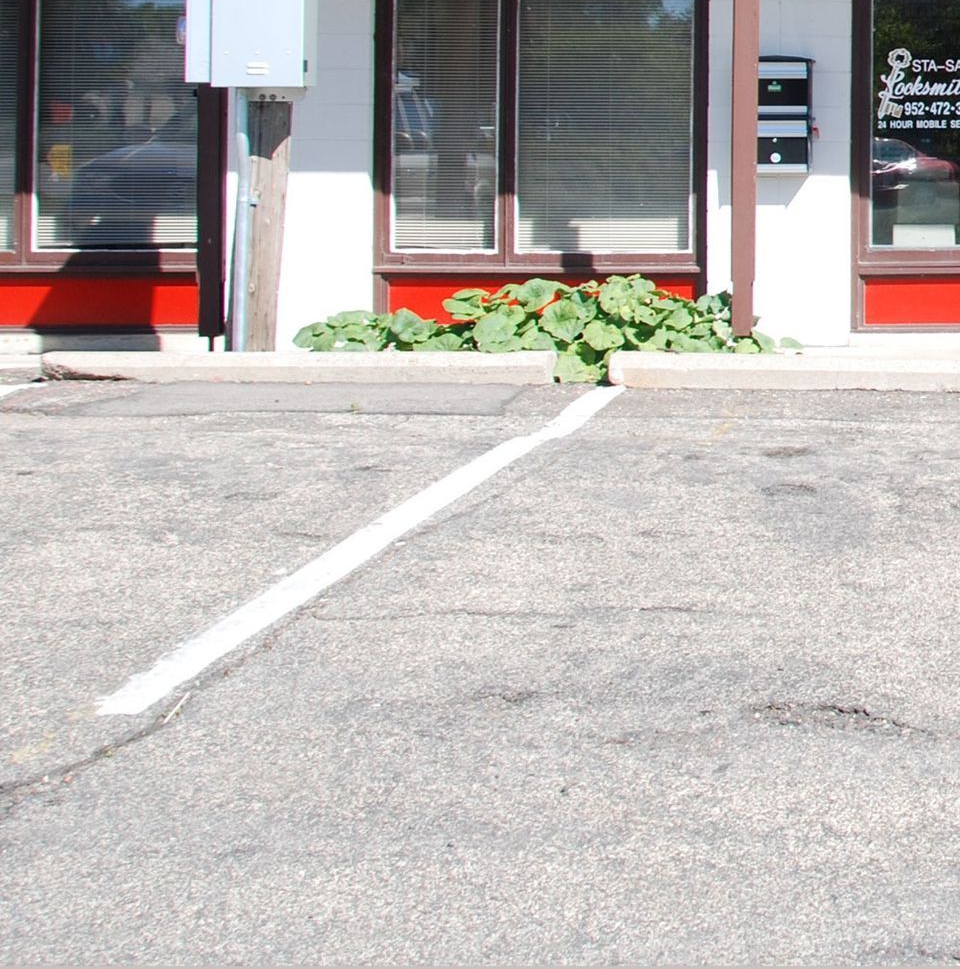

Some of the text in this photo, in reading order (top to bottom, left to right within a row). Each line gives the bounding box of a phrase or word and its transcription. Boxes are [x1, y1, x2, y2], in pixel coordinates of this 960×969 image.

[877, 120, 887, 129] 24
[890, 119, 913, 129] HOUR
[916, 119, 947, 129] MOBILE
